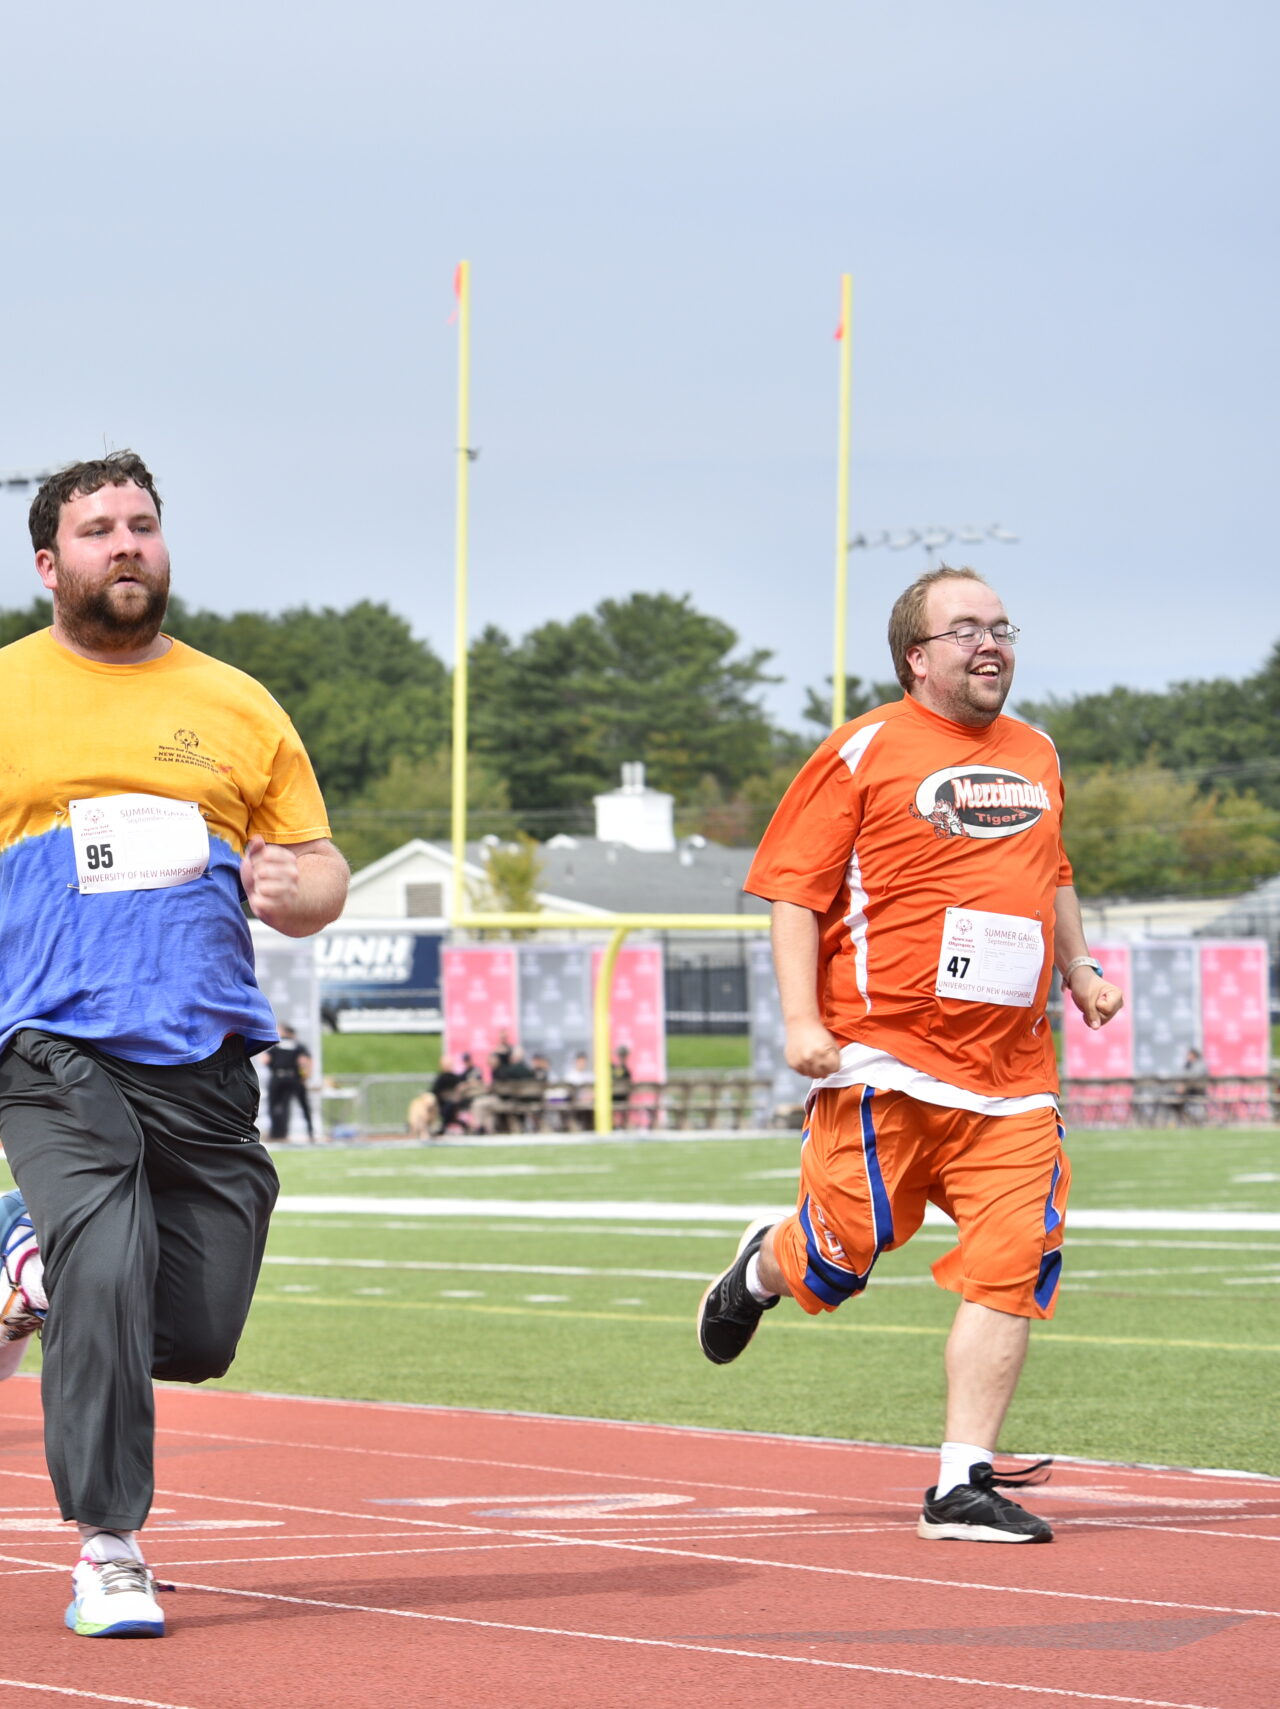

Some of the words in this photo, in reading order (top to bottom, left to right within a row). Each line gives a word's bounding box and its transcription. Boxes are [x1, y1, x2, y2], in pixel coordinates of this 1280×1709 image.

[951, 778, 1051, 811] Merrimack
[120, 807, 161, 818] SUMMER
[975, 810, 1027, 825] Tigers
[86, 844, 113, 870] 95
[81, 872, 125, 884] UNIVERSITY
[127, 871, 137, 880] OF
[139, 870, 157, 879] NEW
[159, 866, 202, 877] HAMPSHIRE
[984, 928, 1017, 941] SUMMER
[987, 938, 1016, 948] September
[314, 935, 411, 965] UNH
[947, 955, 971, 979] 47
[938, 980, 975, 992] UNIVERSITY
[976, 985, 985, 993] OF
[985, 986, 1001, 995] NEW
[1001, 988, 1032, 999] HAMPSHIRE
